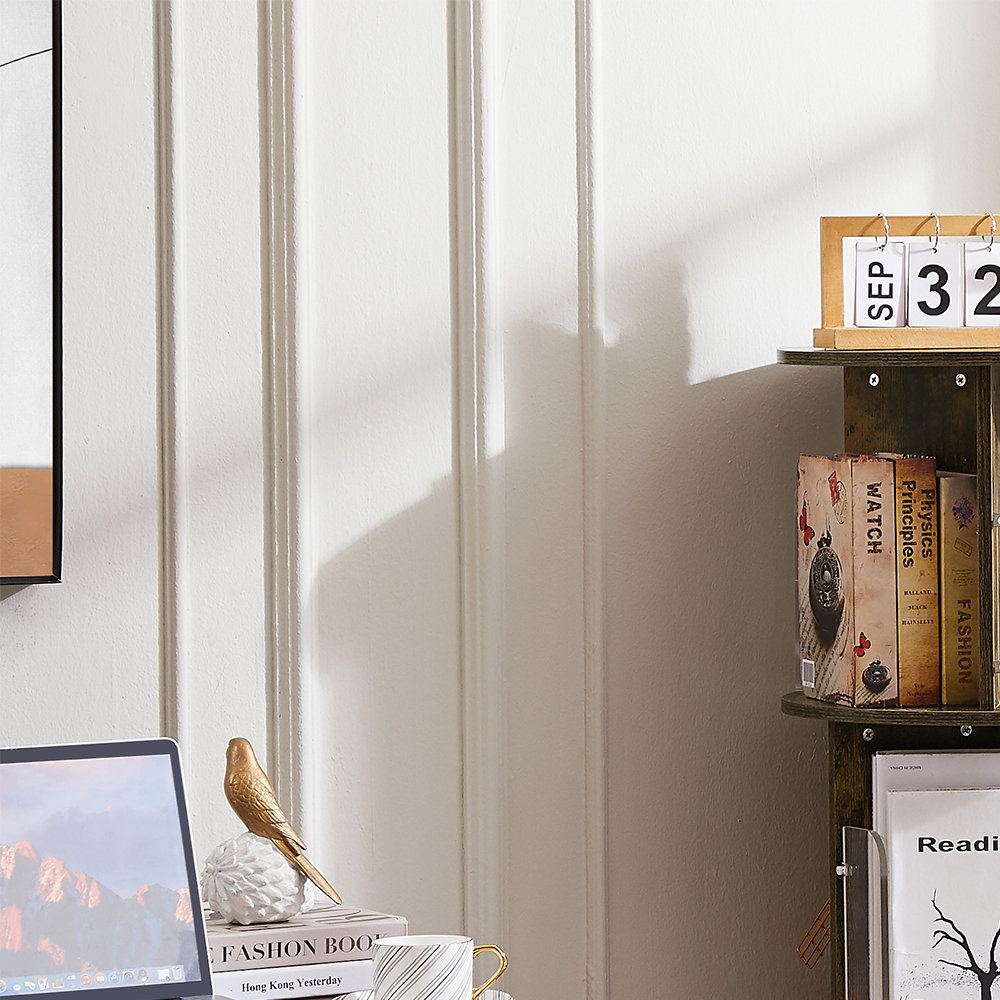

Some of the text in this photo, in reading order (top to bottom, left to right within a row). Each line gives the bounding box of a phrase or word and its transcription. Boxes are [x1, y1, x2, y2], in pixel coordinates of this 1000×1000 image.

[867, 261, 894, 321] SEP
[866, 481, 883, 554] WATCH
[899, 480, 917, 569] Principles
[917, 488, 936, 559] Physics
[957, 599, 973, 684] FASHION
[221, 938, 318, 963] FASHON
[241, 975, 343, 993] Hong Kong Yesterday
